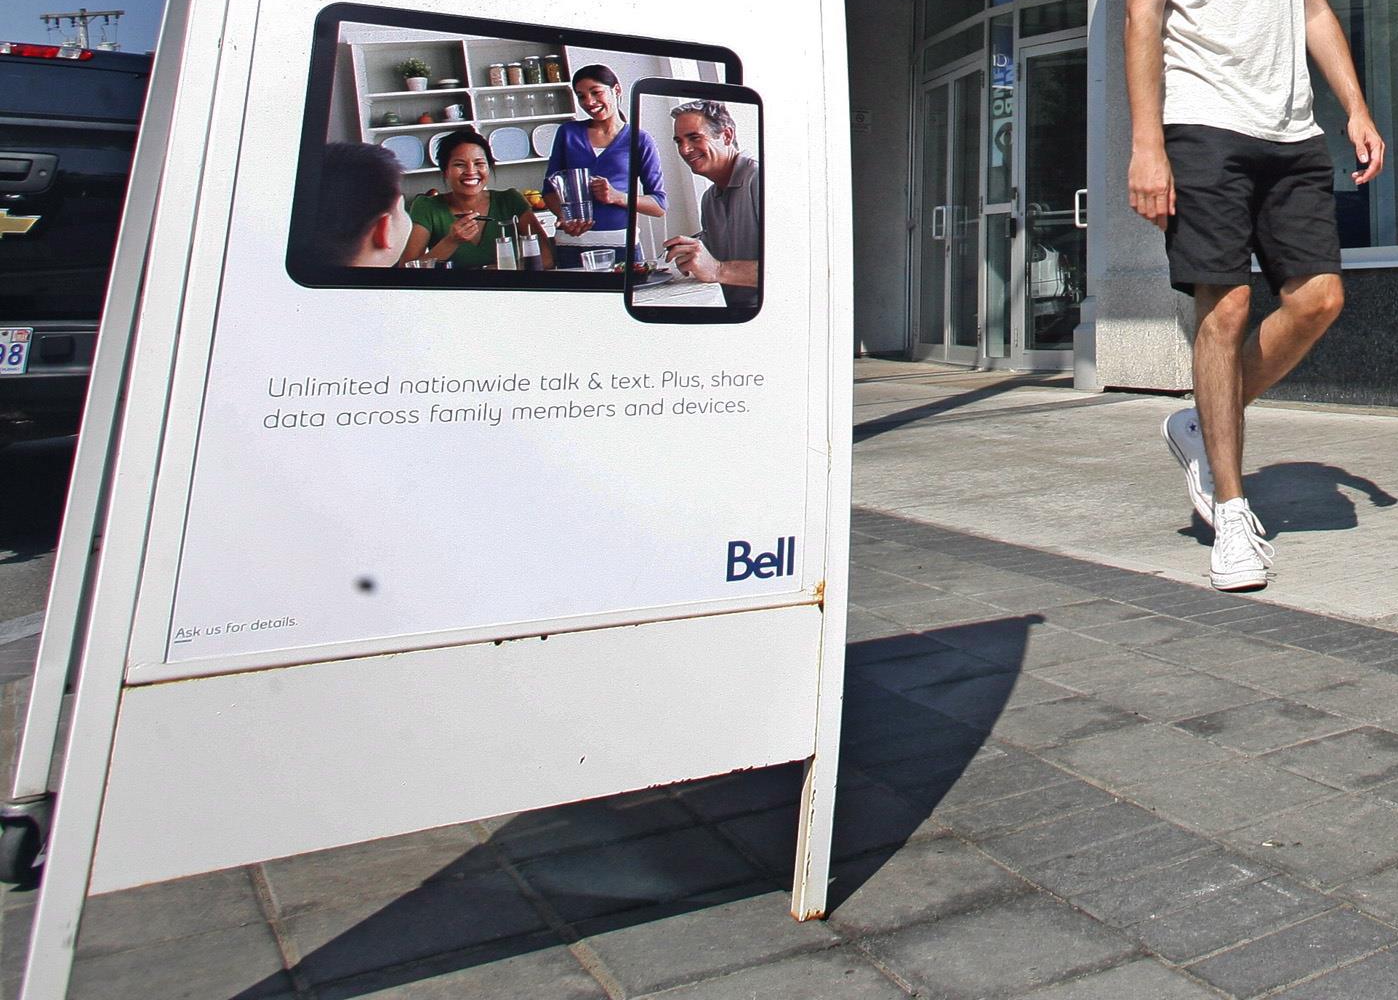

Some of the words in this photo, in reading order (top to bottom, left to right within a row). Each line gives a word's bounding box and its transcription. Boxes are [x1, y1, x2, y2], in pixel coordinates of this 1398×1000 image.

[267, 374, 390, 399] Unlimited
[399, 373, 532, 395] nationwide
[539, 371, 580, 392] talk
[587, 372, 604, 391] &
[610, 371, 655, 390] text.
[661, 370, 705, 392] Plus,
[710, 369, 765, 388] share
[262, 407, 326, 430] data
[336, 408, 420, 428] across
[429, 403, 502, 427] family
[511, 400, 616, 421] members
[624, 397, 664, 417] and
[671, 396, 751, 416] devices.
[726, 535, 796, 582] Bell
[174, 626, 201, 639] Ask
[205, 625, 222, 636] us
[225, 622, 247, 633] for
[250, 616, 299, 631] details.
